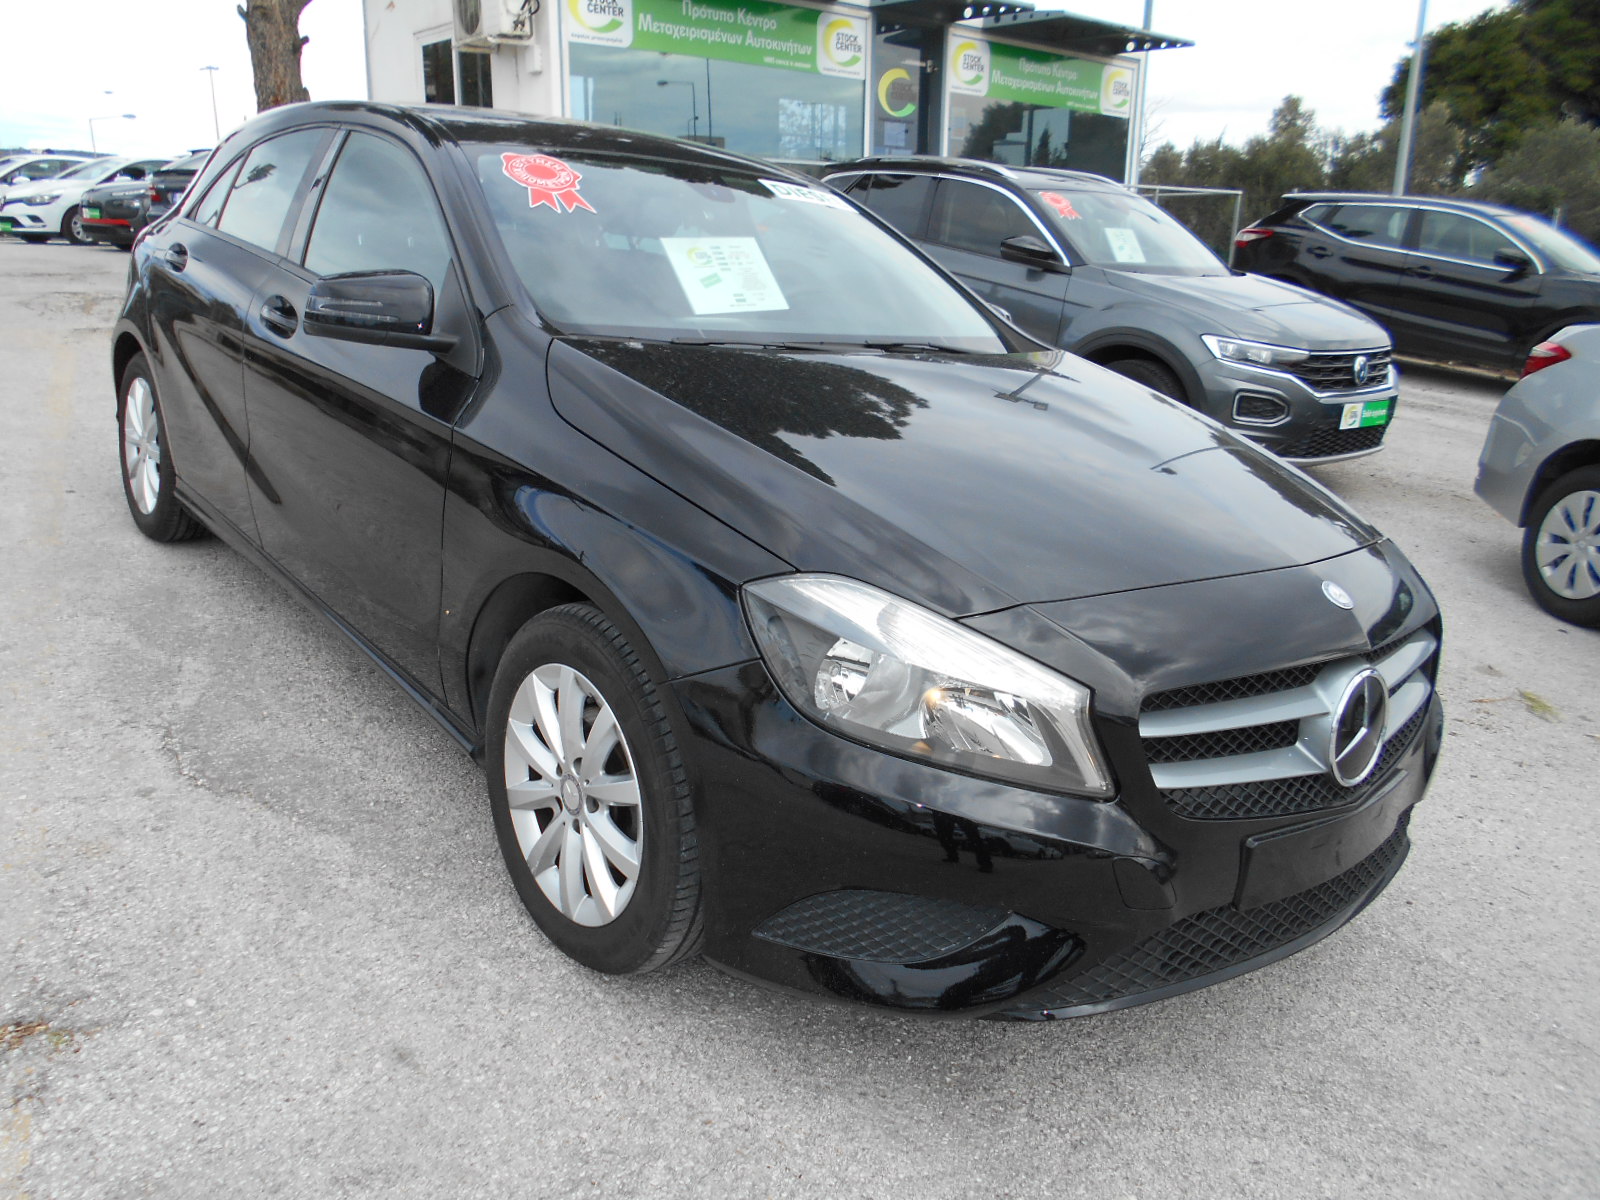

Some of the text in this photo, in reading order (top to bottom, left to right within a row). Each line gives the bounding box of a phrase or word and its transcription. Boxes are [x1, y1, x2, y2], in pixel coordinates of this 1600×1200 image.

[587, 3, 624, 17] CENTER
[683, 0, 777, 31] Πρότυπο Κέντρο
[638, 12, 813, 55] Μεταχειρισμένων Αυτοκινήτων
[836, 32, 859, 42] STOCK
[835, 42, 863, 53] CENTER
[963, 54, 982, 62] STOCK
[962, 61, 985, 72] CENTER
